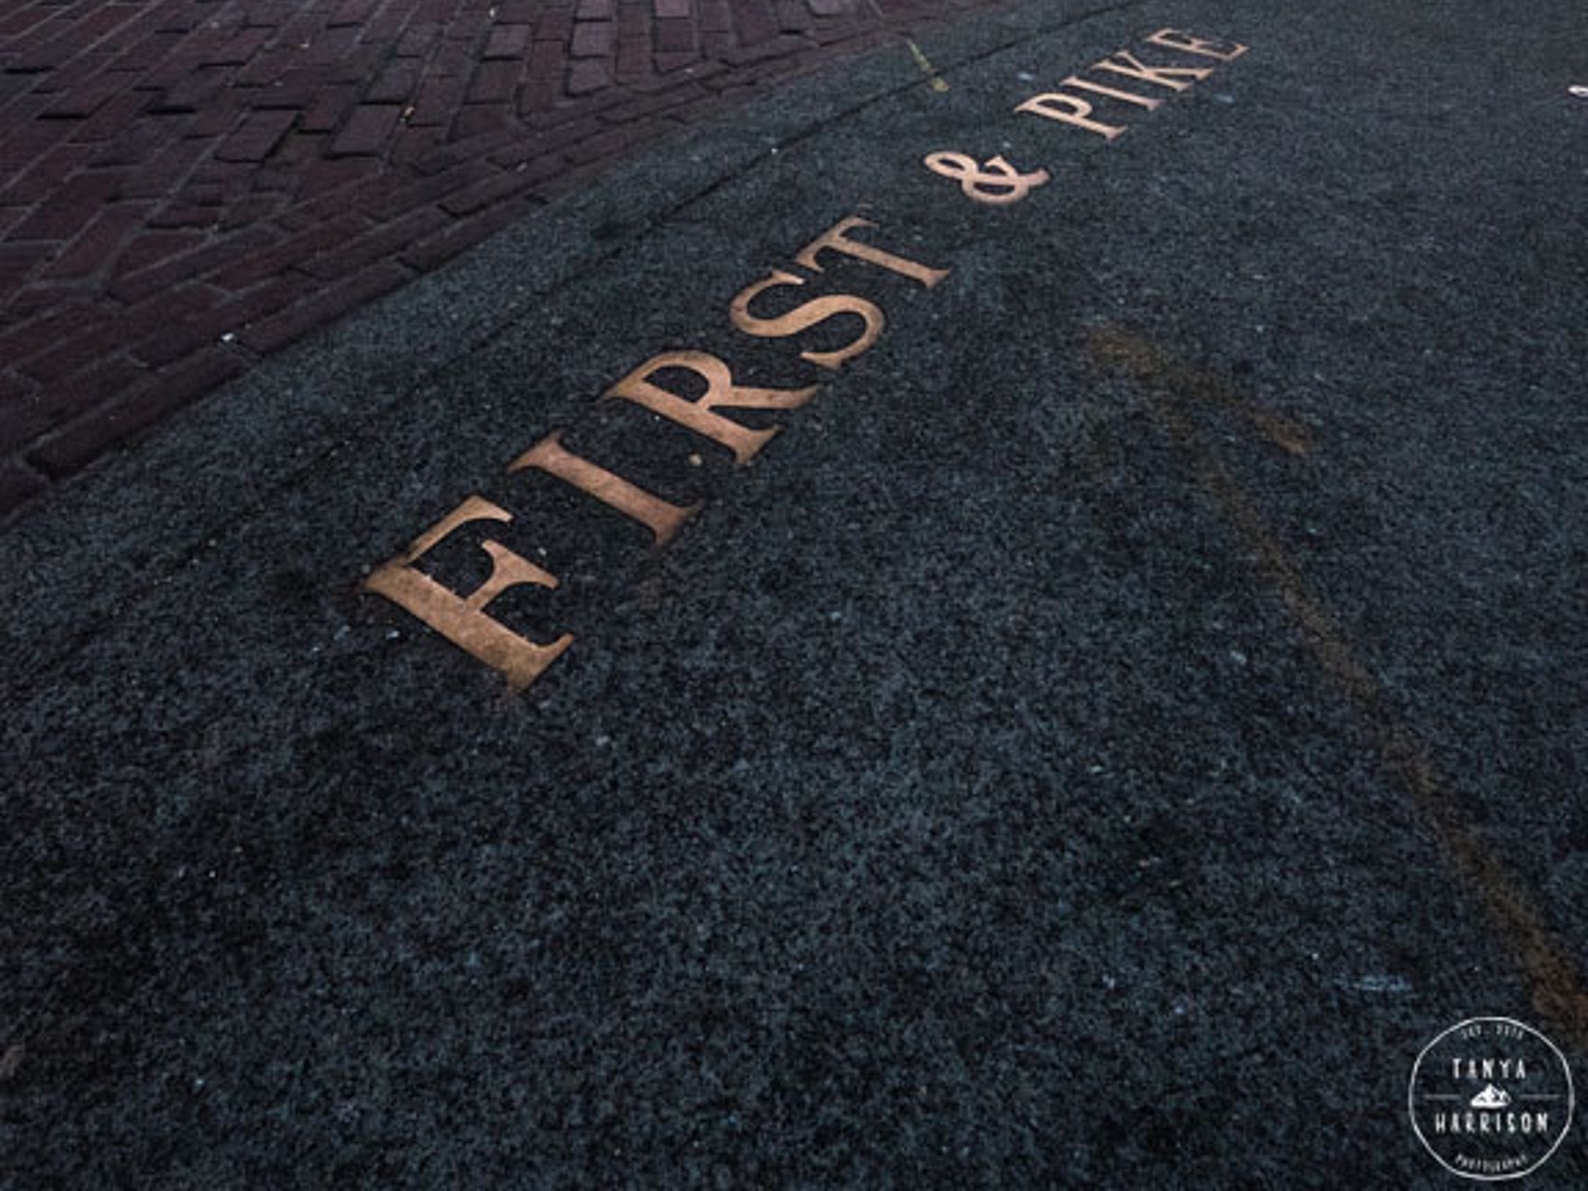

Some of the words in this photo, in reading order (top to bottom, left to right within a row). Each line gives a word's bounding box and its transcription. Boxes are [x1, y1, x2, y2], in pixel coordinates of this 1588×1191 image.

[359, 216, 950, 696] FIRST
[923, 150, 1051, 204] &
[1014, 27, 1249, 140] PIKE
